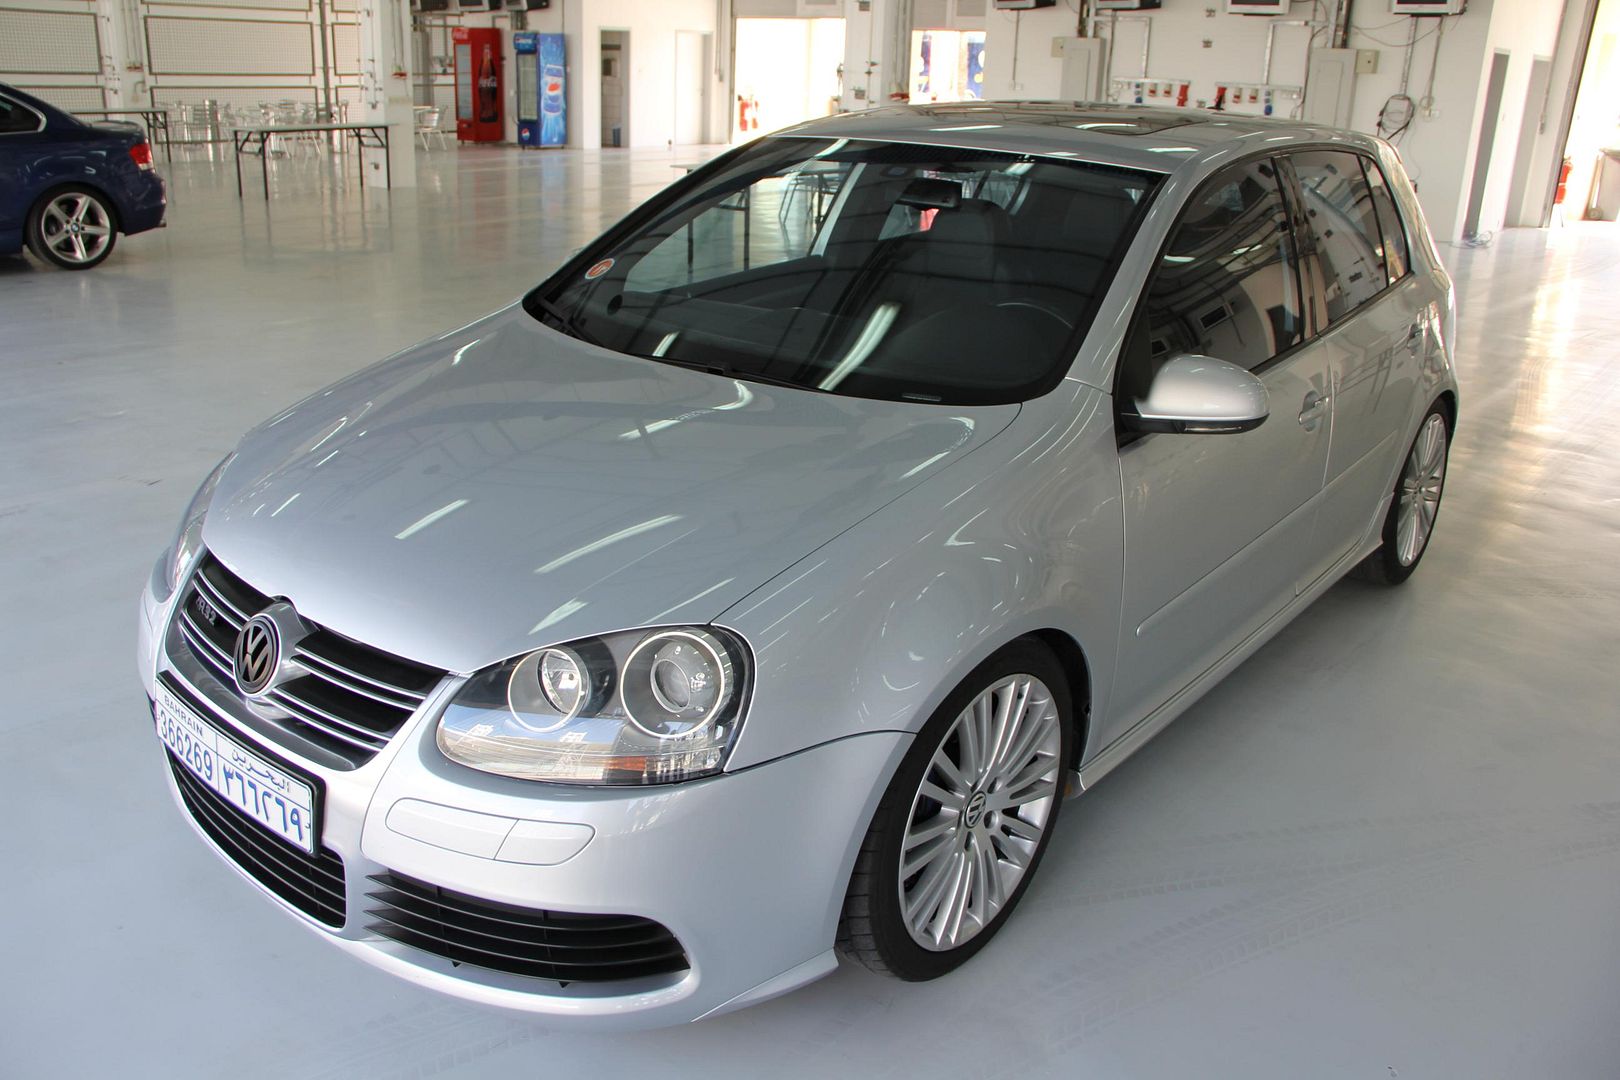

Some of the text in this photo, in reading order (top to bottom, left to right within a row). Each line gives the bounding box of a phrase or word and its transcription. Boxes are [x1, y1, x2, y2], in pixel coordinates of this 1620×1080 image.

[164, 694, 204, 737] BAHRAIN
[161, 710, 213, 782] 366269
[231, 749, 291, 793] البحرين
[222, 764, 303, 842] ٣٦٦٢٦٩
